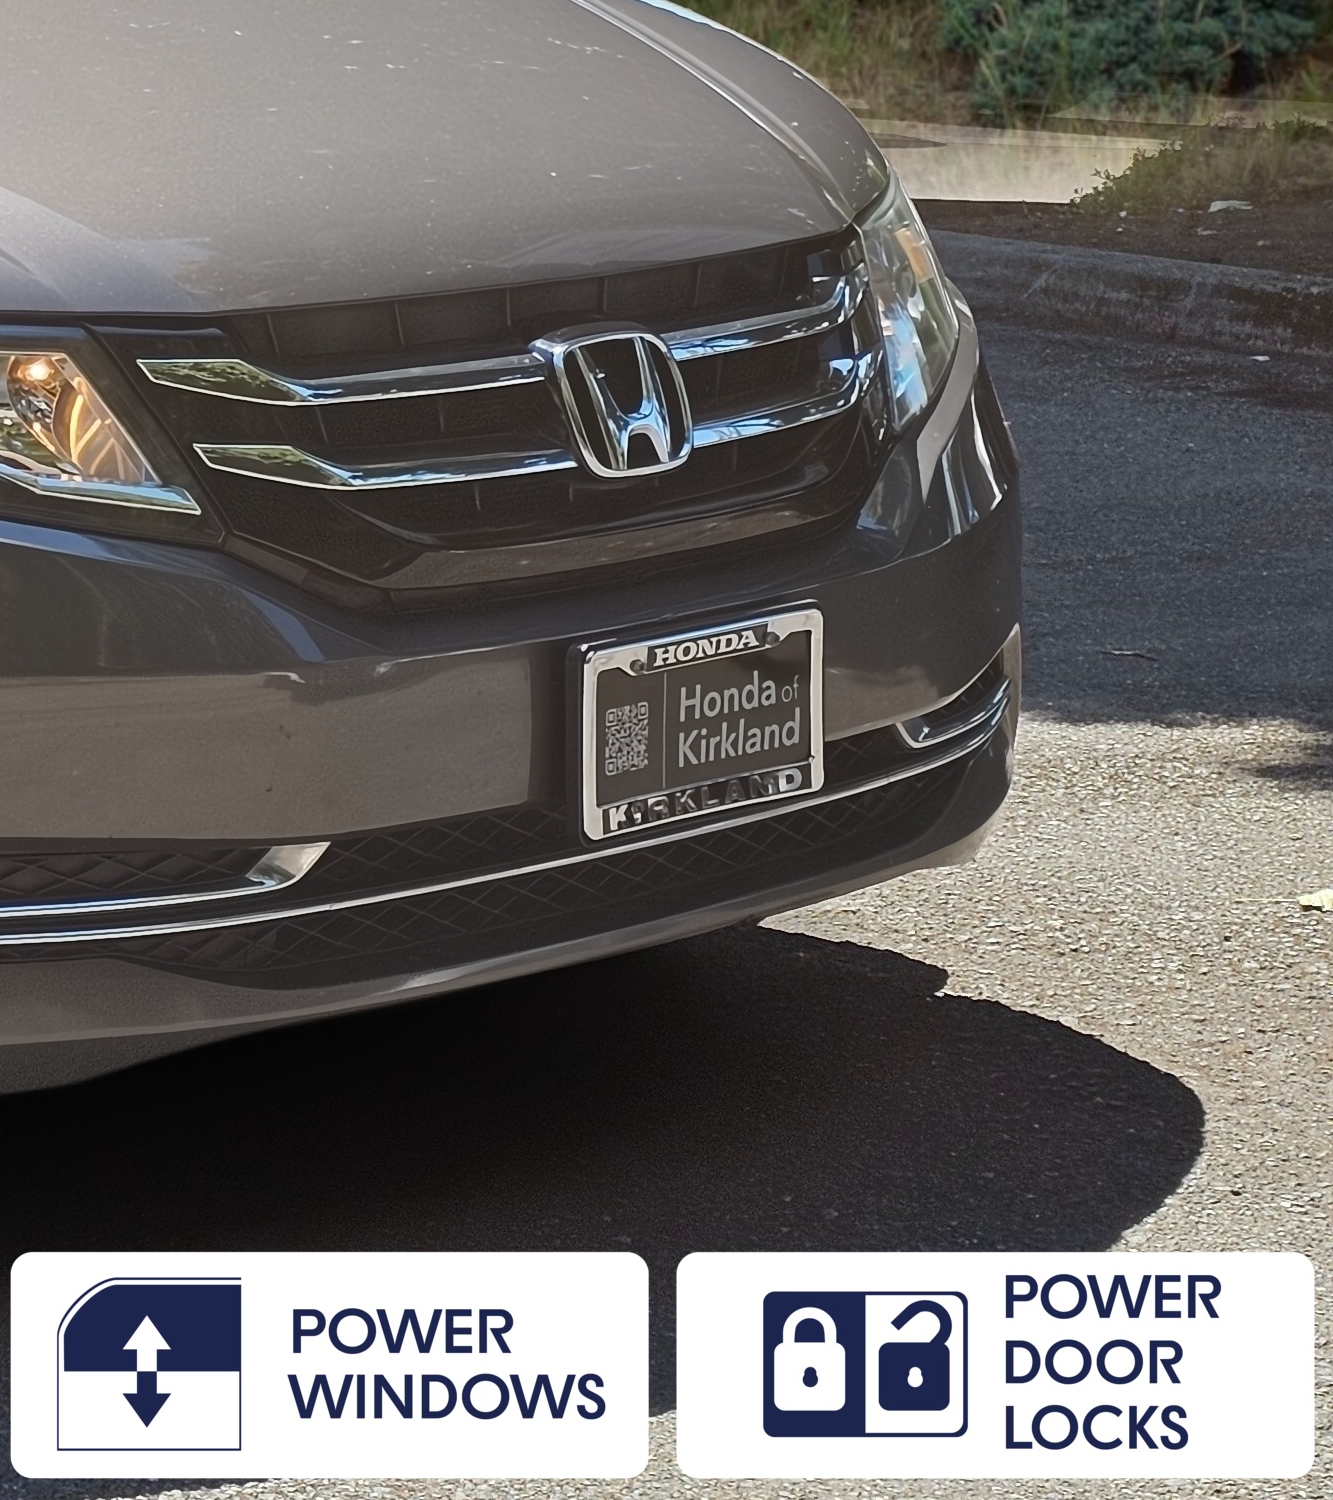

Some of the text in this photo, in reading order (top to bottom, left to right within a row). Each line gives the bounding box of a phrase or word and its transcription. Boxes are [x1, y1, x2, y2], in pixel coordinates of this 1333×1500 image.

[653, 630, 759, 667] HONDA
[679, 670, 799, 722] Honda of
[678, 707, 800, 768] Kirkland
[609, 767, 803, 831] KIRKLAND
